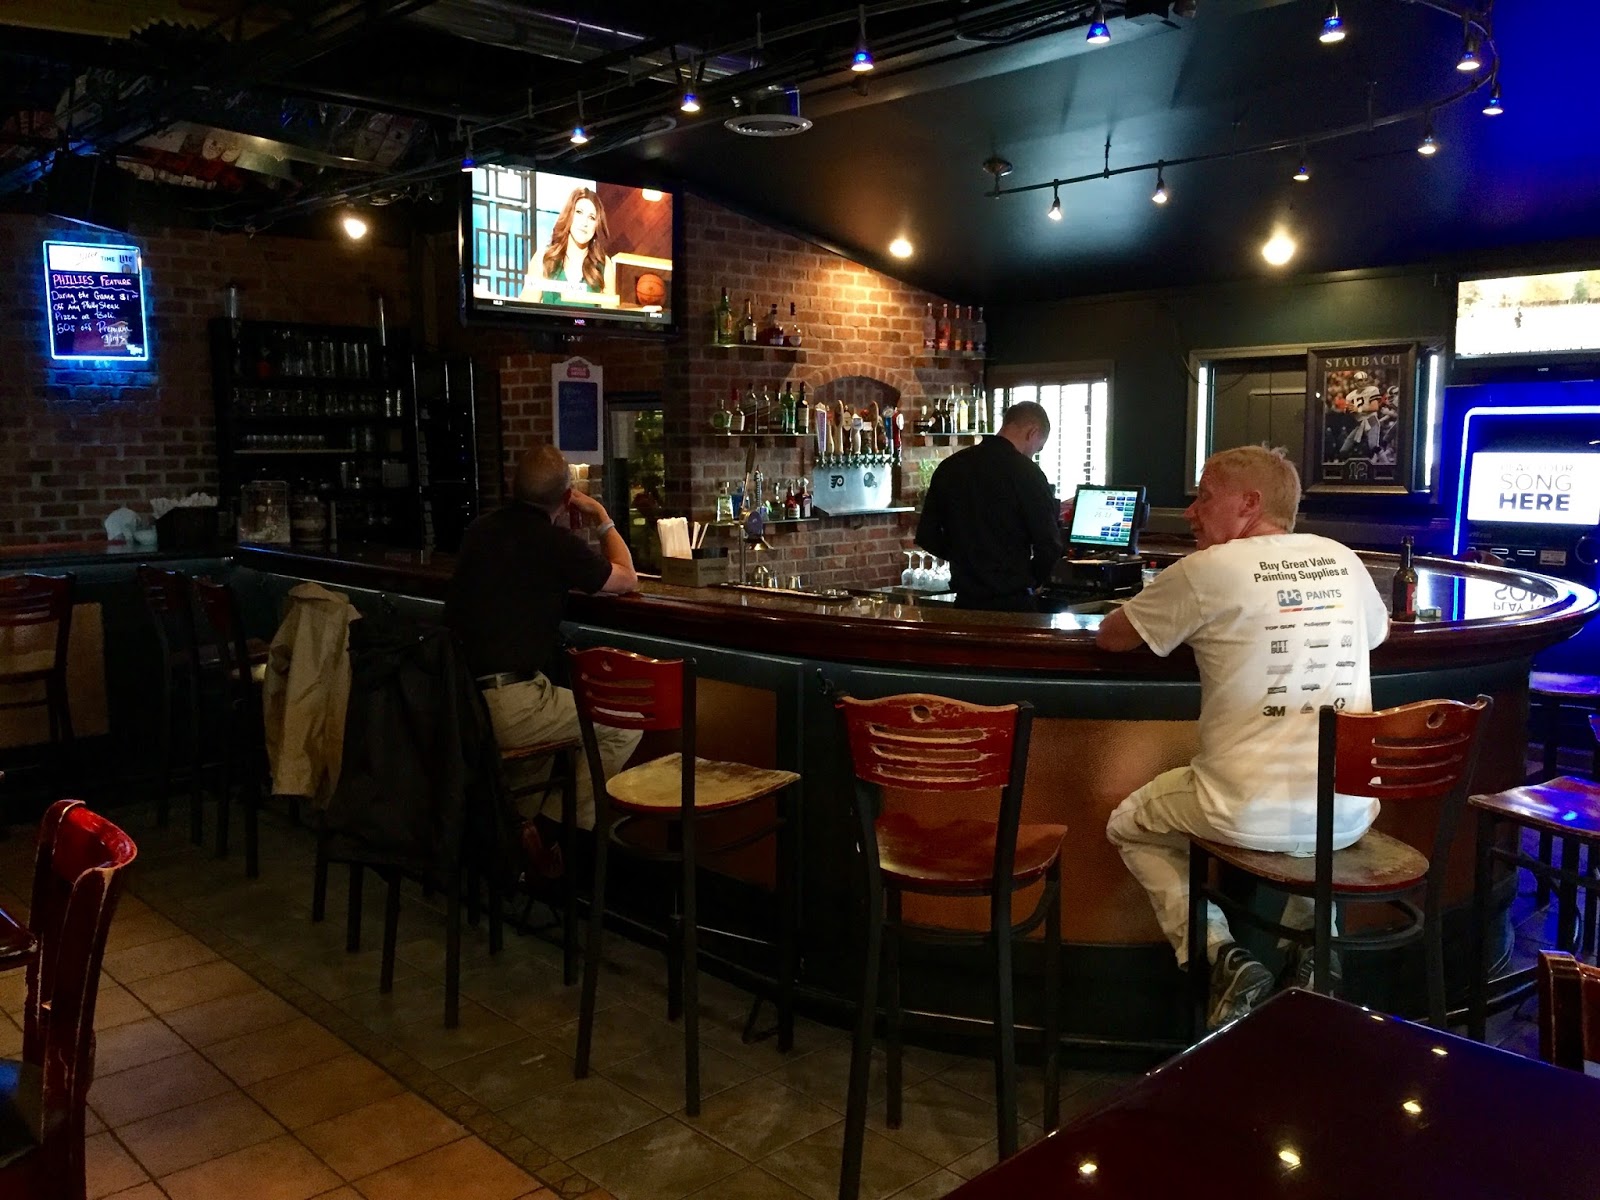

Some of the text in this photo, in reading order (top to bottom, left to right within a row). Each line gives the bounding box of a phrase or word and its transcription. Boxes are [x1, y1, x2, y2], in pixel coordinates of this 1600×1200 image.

[53, 274, 94, 286] PHILLIES
[51, 291, 76, 304] During
[78, 291, 89, 299] the
[94, 291, 115, 300] Game
[55, 312, 77, 321] Pizza
[1325, 355, 1401, 368] STAUBACH
[1501, 473, 1572, 492] SONG
[1499, 492, 1571, 512] HERE
[1259, 556, 1337, 571] Buy Great Value
[1253, 567, 1349, 583] Painting Supplies at
[1306, 589, 1342, 601] PAINTS
[1262, 705, 1287, 717] 3M
